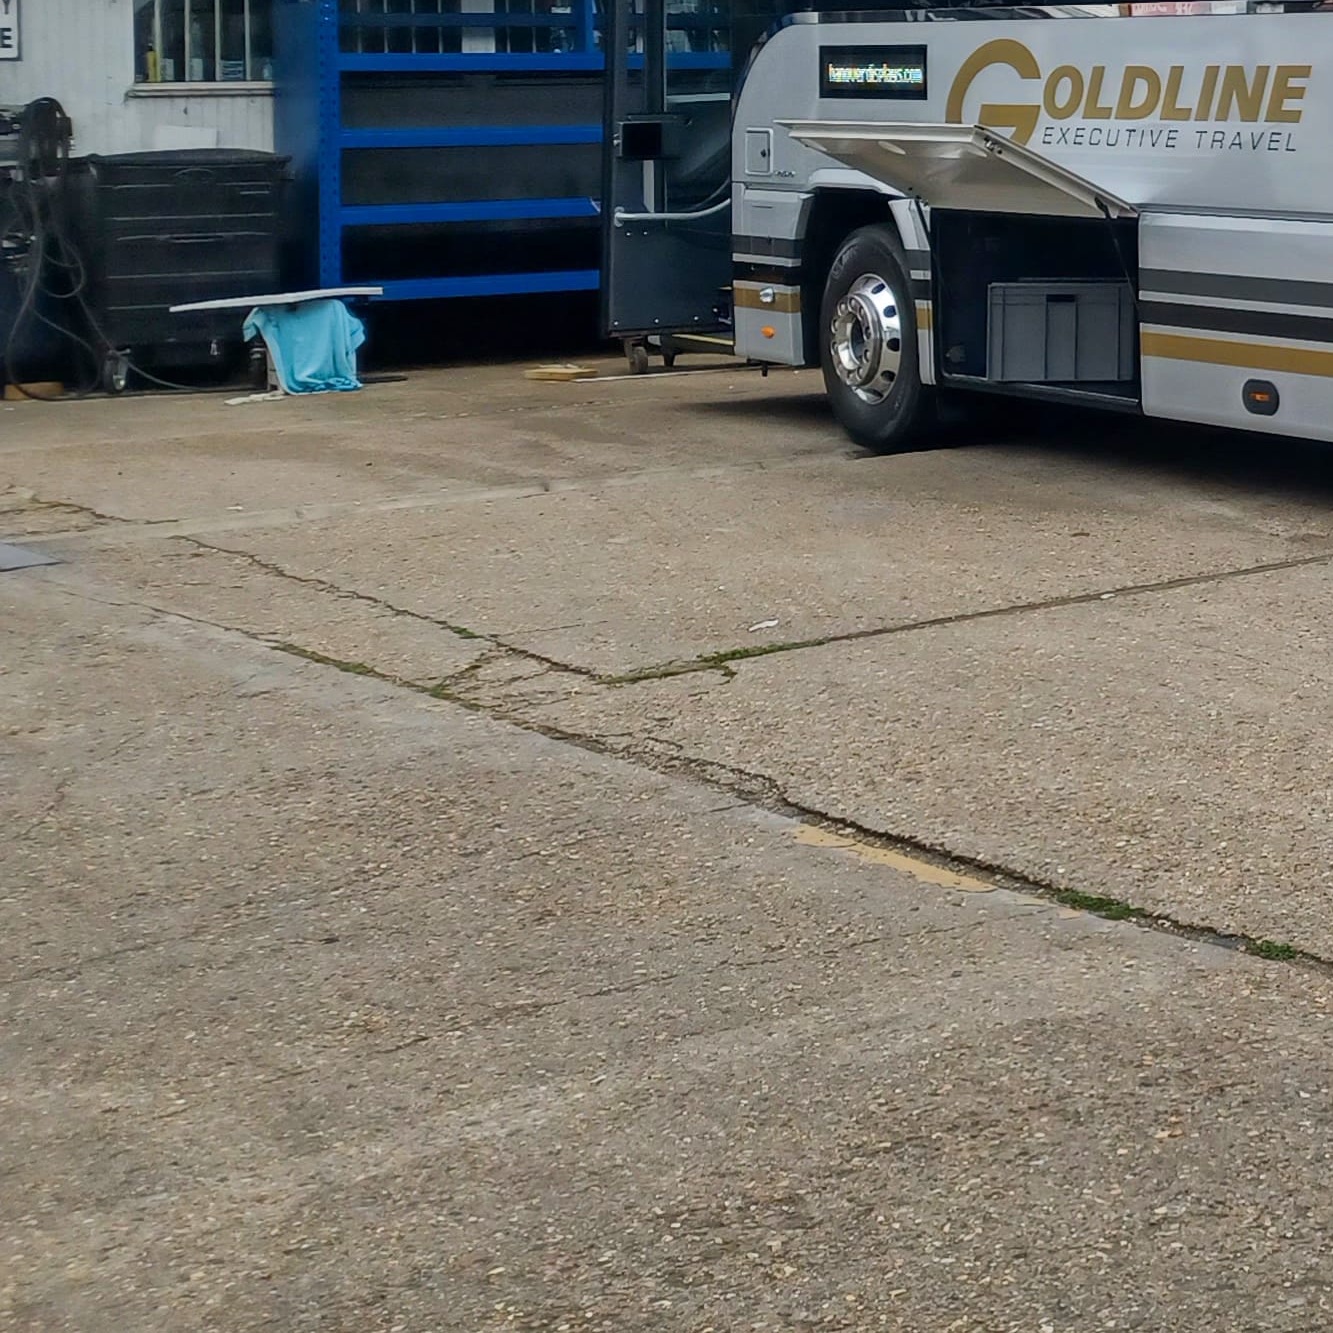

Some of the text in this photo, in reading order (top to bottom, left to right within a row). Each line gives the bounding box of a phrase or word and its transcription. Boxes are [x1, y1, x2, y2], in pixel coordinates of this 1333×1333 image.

[945, 38, 1312, 146] GOLDLINE
[1041, 127, 1297, 152] EXECUTIVE TRAVEL
